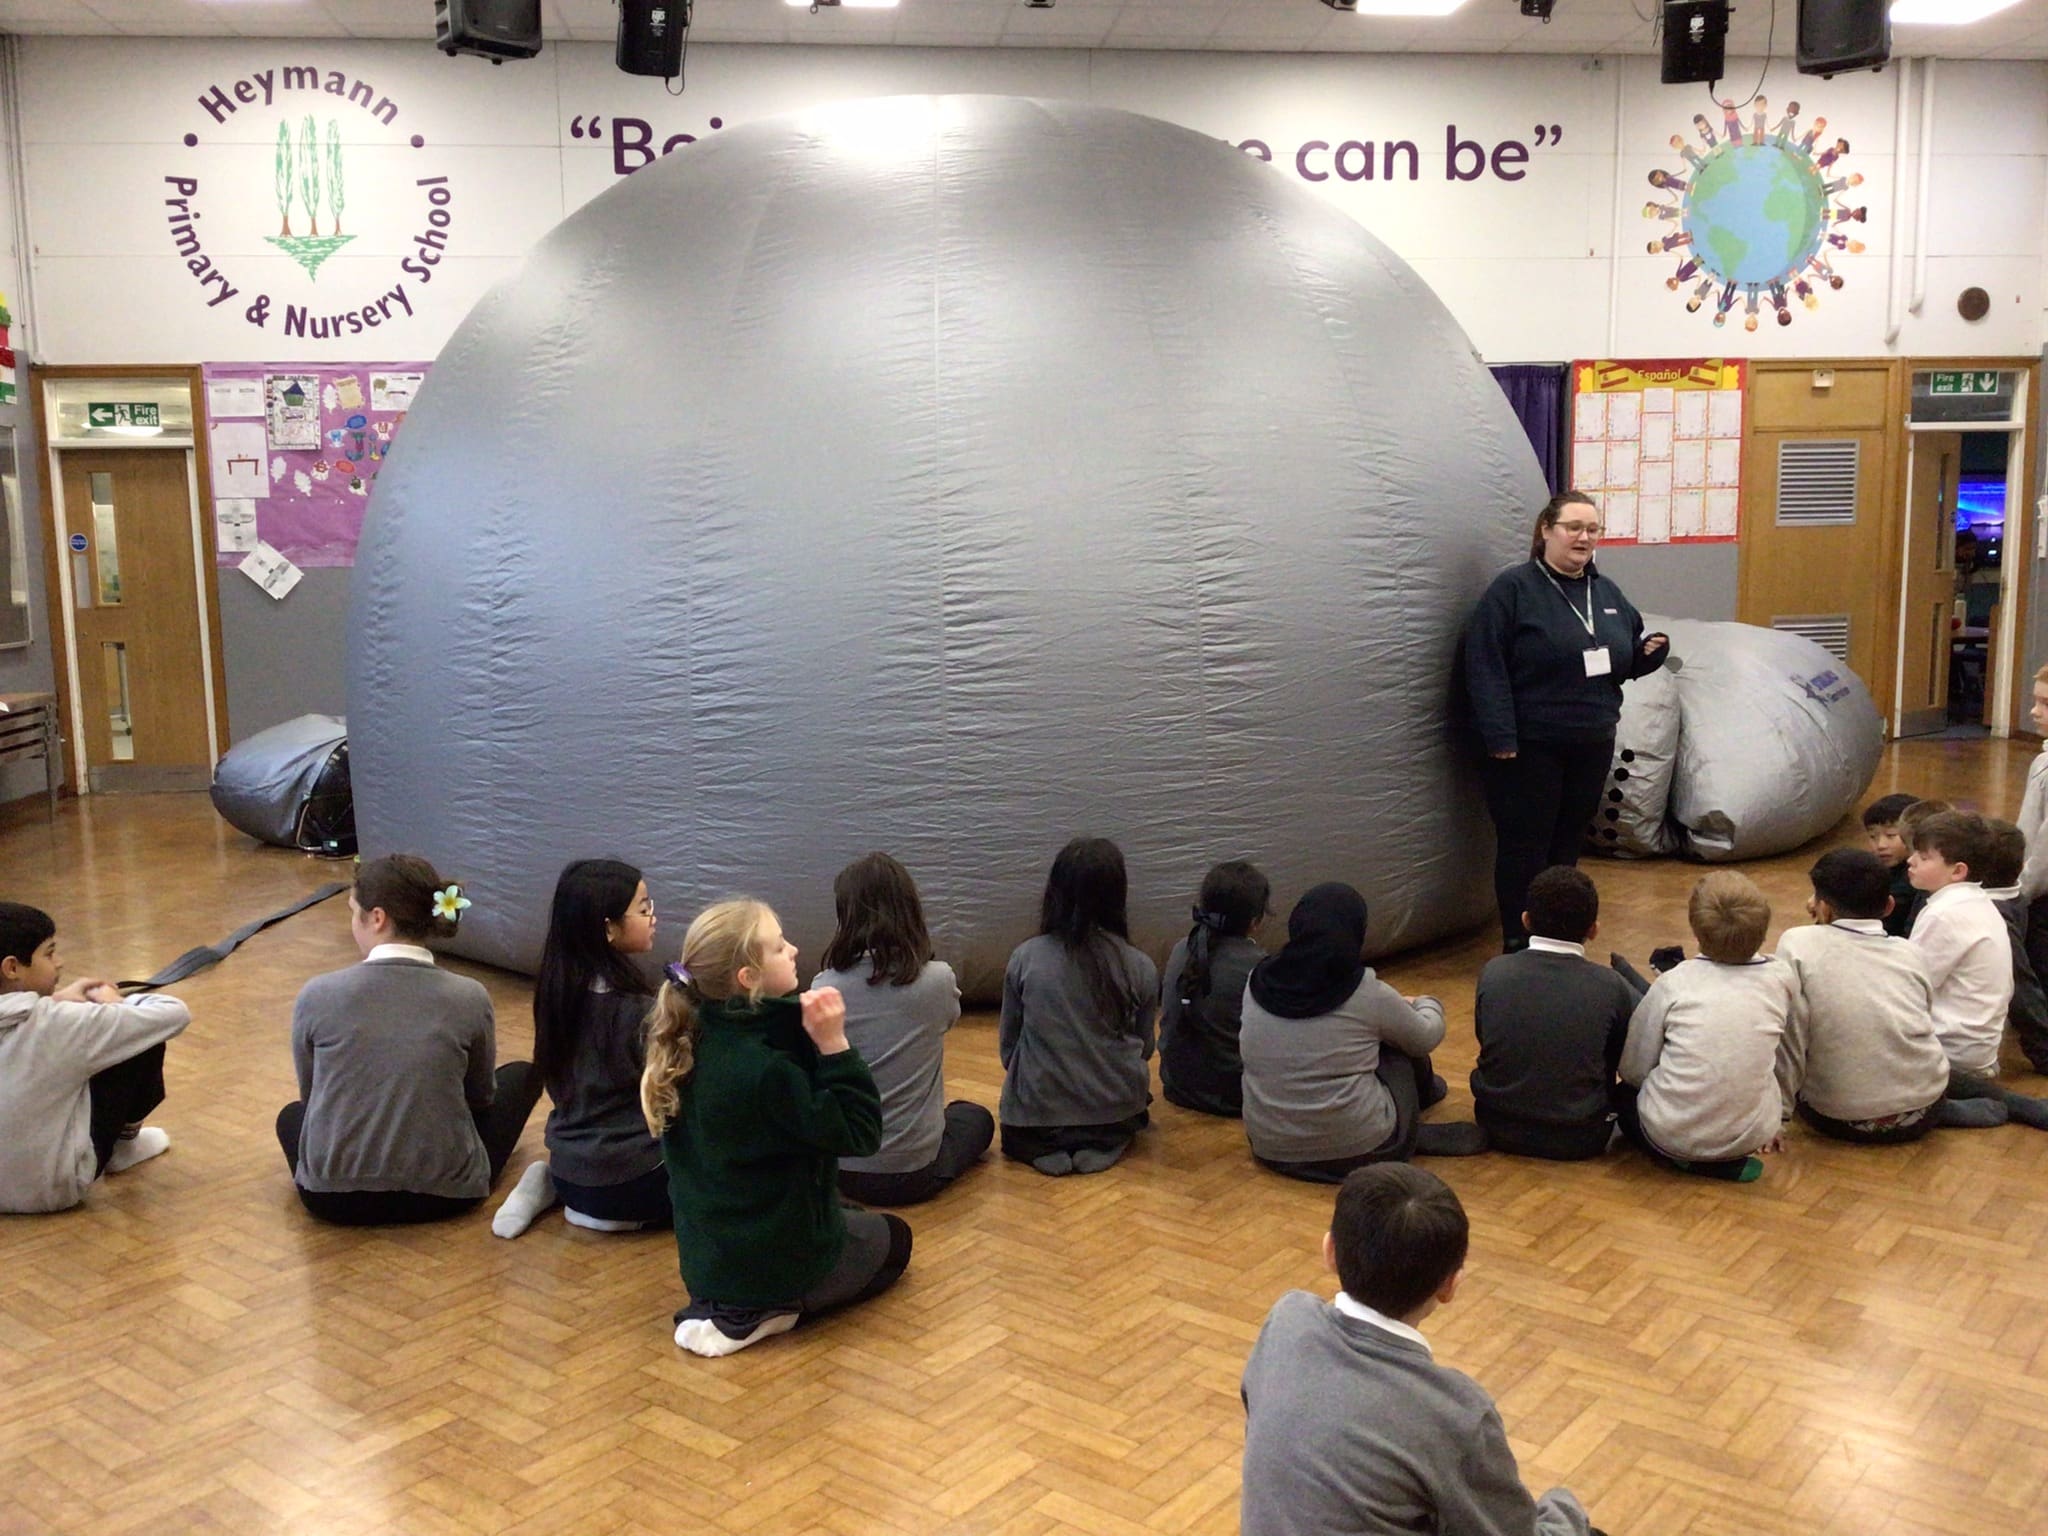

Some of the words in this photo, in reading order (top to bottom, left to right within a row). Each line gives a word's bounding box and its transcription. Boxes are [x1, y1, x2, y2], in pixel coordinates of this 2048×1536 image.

[197, 66, 398, 126] Heymann
[1297, 139, 1420, 182] can
[164, 176, 239, 307] Primary
[245, 294, 271, 328] &
[284, 284, 413, 339] Nursery
[401, 175, 452, 283] School
[1638, 368, 1682, 381] Español
[1936, 373, 1956, 382] Fire
[1936, 383, 1954, 392] exit
[134, 404, 157, 416] Fire
[135, 414, 158, 425] exit
